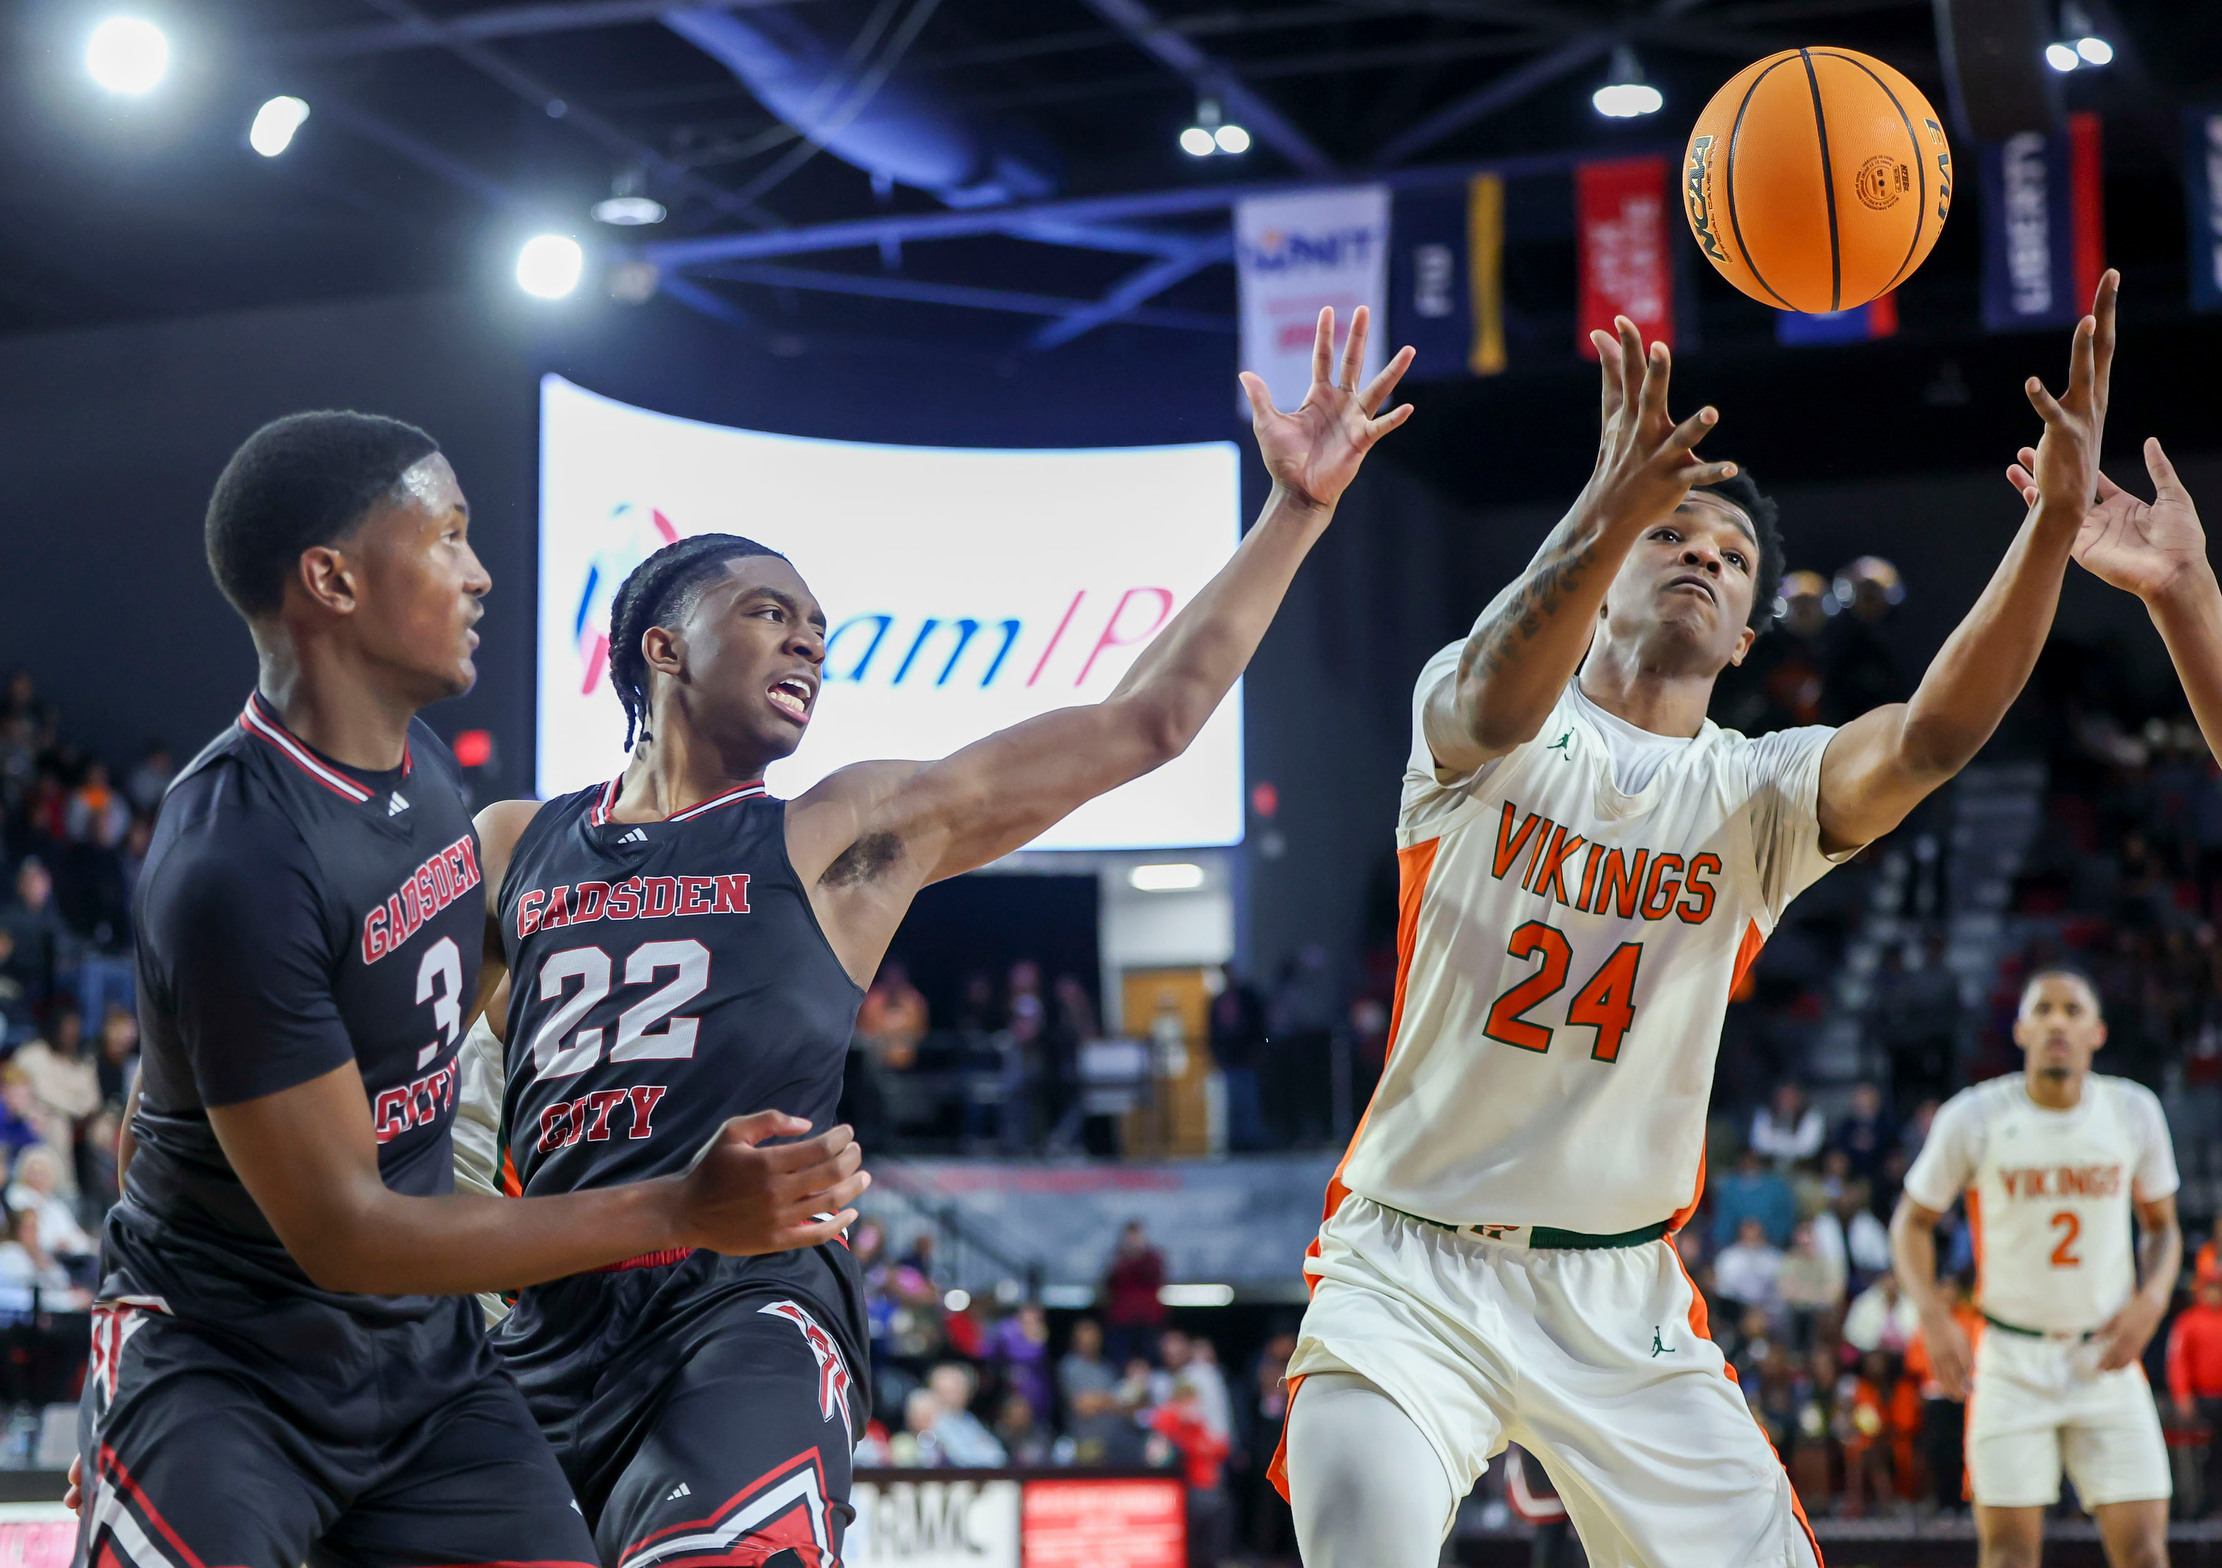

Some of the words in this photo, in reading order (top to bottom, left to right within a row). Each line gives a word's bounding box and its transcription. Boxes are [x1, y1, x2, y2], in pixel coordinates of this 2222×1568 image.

[1688, 135, 1729, 264] NCAA
[361, 834, 482, 965] GADSDEN
[517, 873, 751, 940] GADSDEN
[1491, 799, 1722, 925] VIKINGS
[416, 935, 463, 1071] 3
[532, 938, 711, 1084] 22
[1482, 919, 1644, 1064] 24
[536, 1085, 667, 1154] CITY
[1999, 1162, 2123, 1200] VIKINGS
[2049, 1211, 2082, 1268] 2
